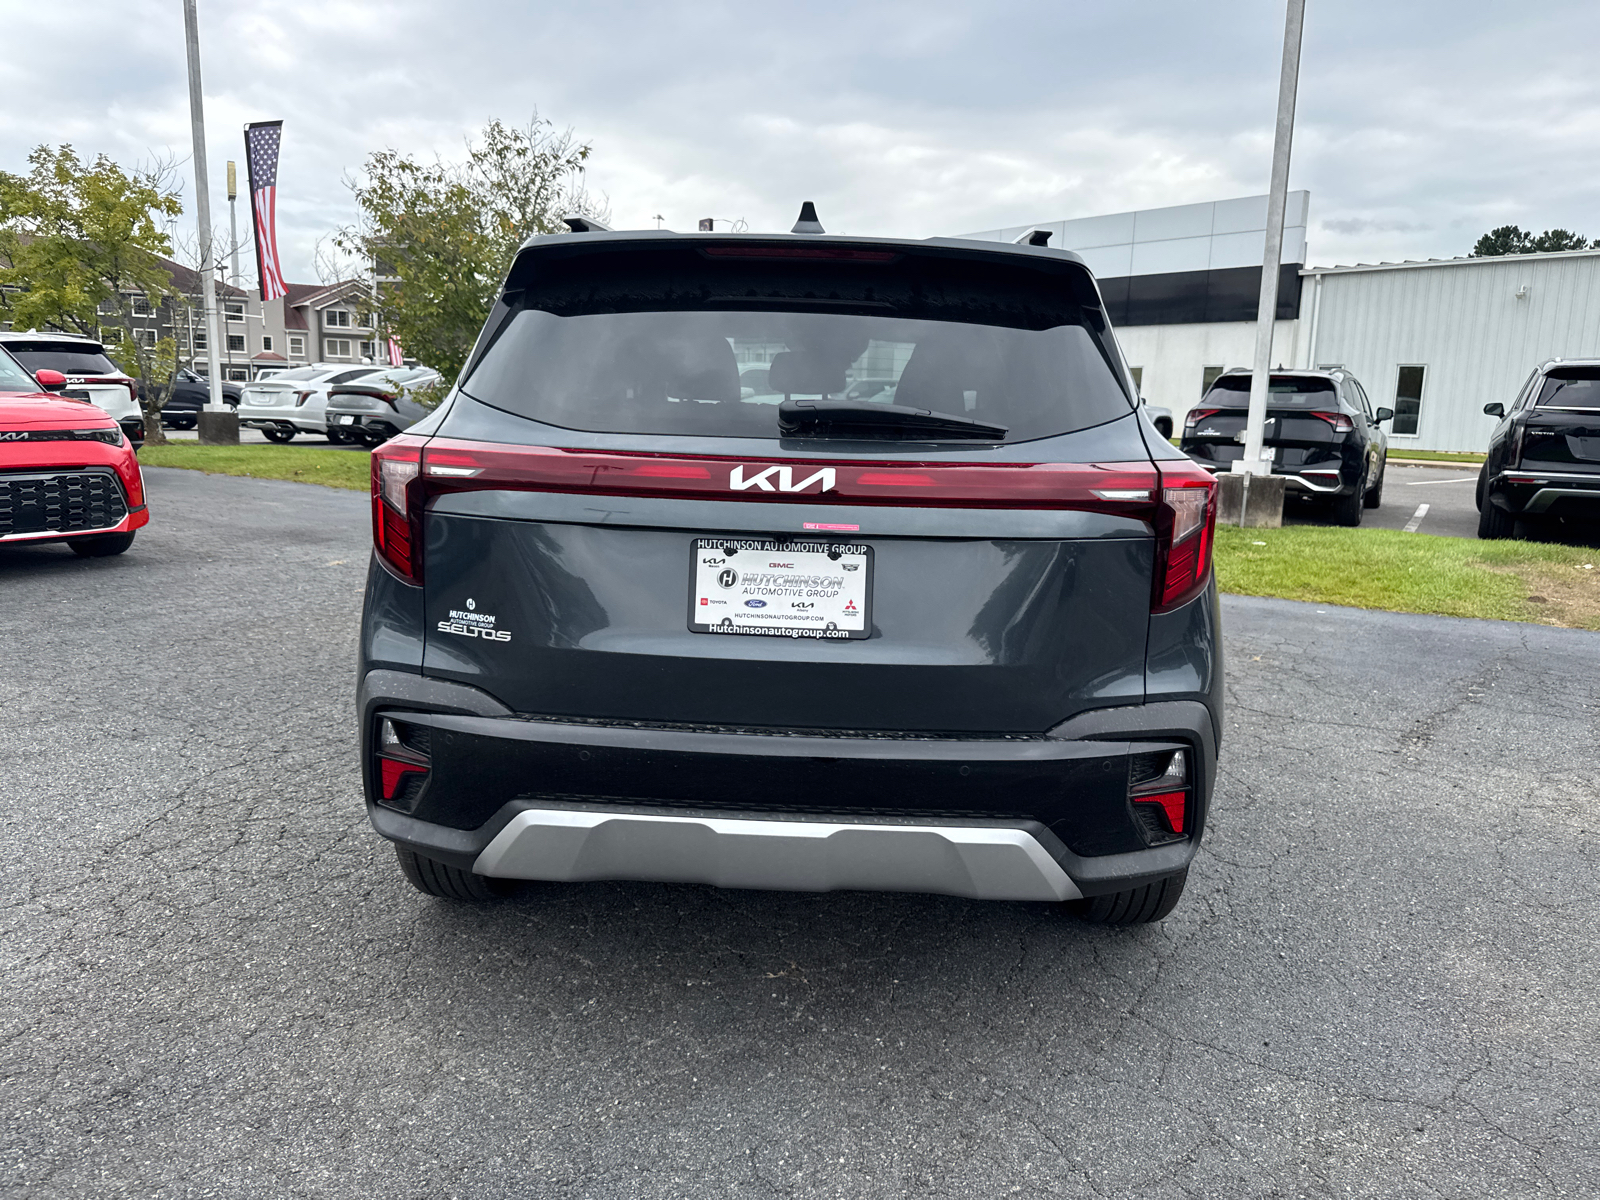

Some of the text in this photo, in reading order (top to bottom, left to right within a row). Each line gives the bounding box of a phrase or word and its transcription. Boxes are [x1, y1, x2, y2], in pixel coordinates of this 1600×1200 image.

[729, 464, 836, 493] KIA
[697, 539, 868, 555] HUTCHINSON AUTOMOTIVE GROUP
[702, 557, 726, 565] KIA
[741, 573, 844, 589] HUTCHINSON
[742, 587, 839, 599] AUTOMOTIVE GROUP
[747, 600, 764, 608] Ford
[791, 601, 815, 609] KIA
[449, 610, 495, 623] HUTCHINSON
[734, 613, 825, 621] HUTCHINSONAUTOGROUP.COM
[450, 618, 494, 629] AUTOMOTIVE GROUP
[437, 621, 512, 642] SELTOS
[709, 624, 849, 638] Hutchinsonautogroup.com
